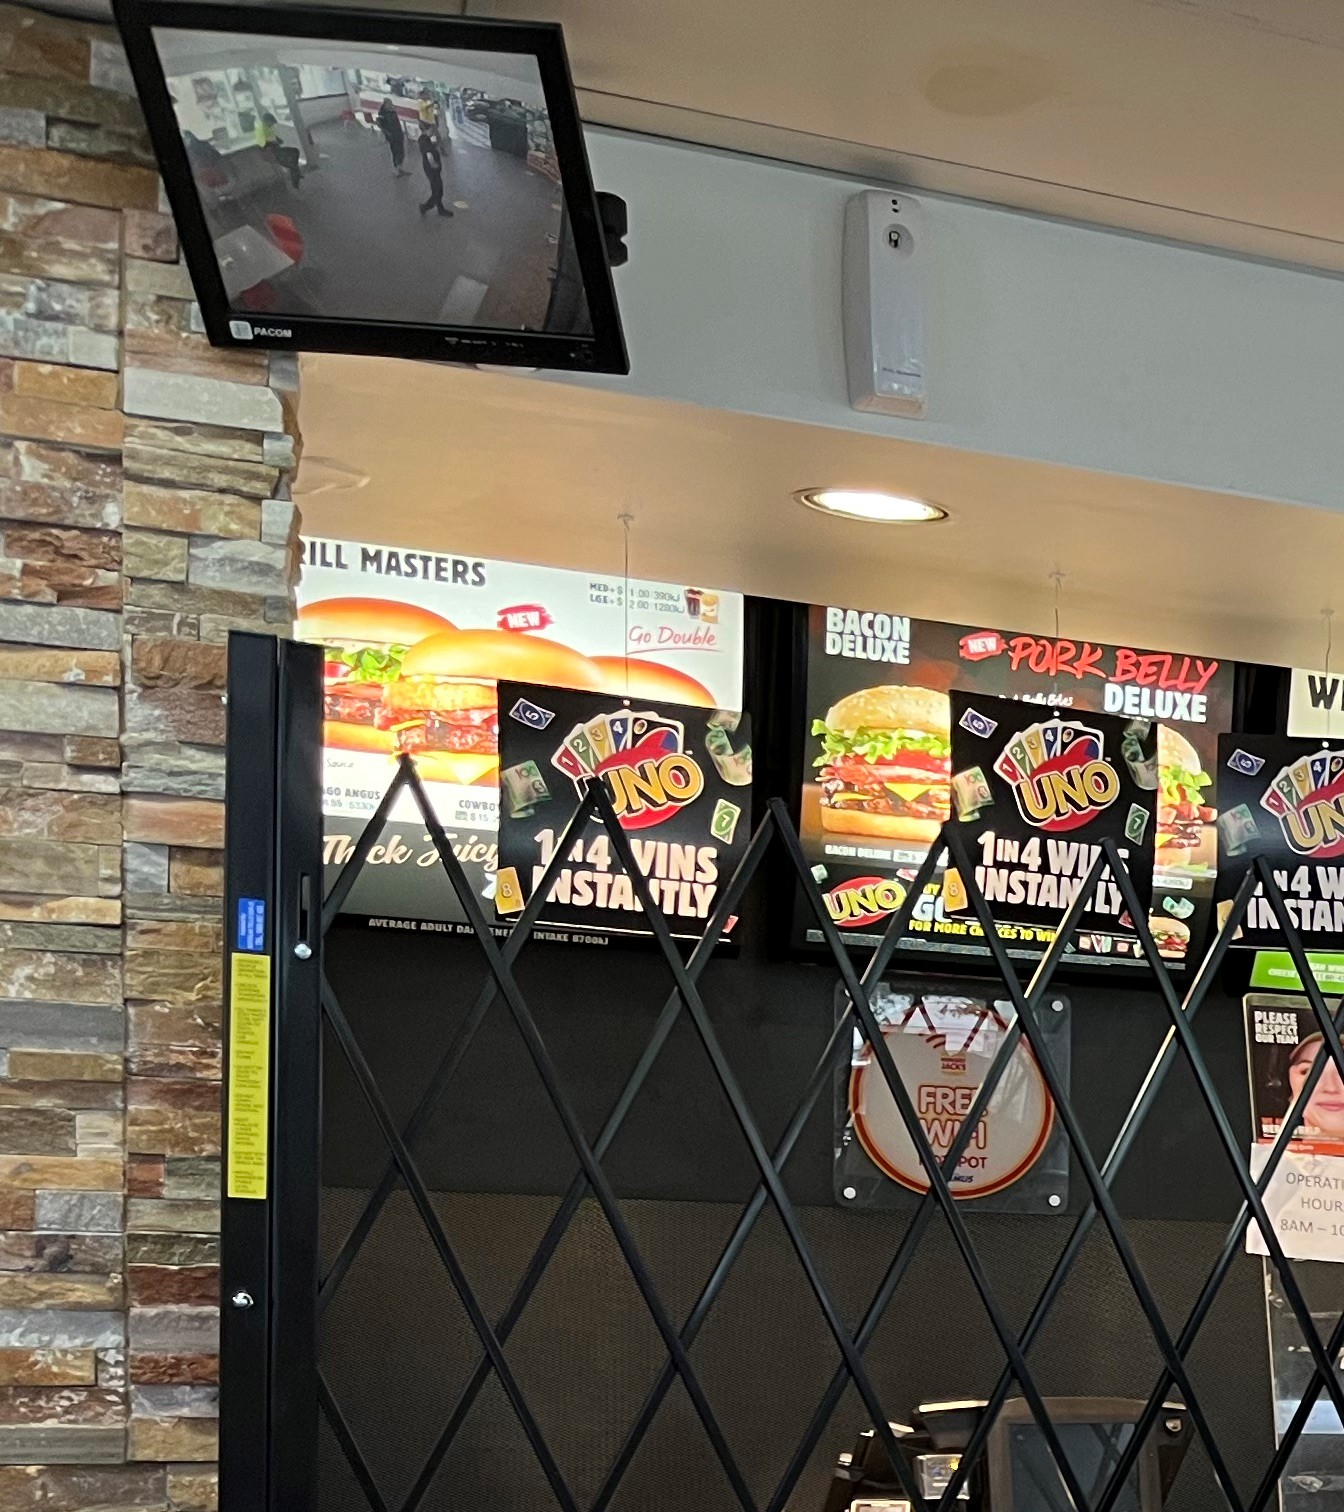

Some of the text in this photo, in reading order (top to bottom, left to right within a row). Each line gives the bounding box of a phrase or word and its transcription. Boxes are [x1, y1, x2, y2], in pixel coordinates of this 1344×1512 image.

[253, 327, 292, 338] PACOM
[360, 547, 486, 588] MASTERS
[506, 612, 540, 630] NEW
[826, 607, 911, 642] BACON
[629, 626, 717, 645] Go Double
[825, 631, 910, 665] DELUXE
[967, 636, 997, 654] NEW
[1008, 636, 1219, 693] PORK BELLY
[1103, 683, 1208, 724] DELUXE
[345, 787, 381, 801] ANGUS
[1019, 763, 1118, 820] UNO
[586, 835, 612, 872] 4
[977, 831, 996, 867] 1
[996, 838, 1020, 863] IN
[1021, 837, 1042, 872] 4
[1290, 865, 1312, 898] 4
[822, 879, 908, 920] UNO
[368, 918, 417, 931] AVERAGE
[420, 922, 454, 934] ADULT
[533, 931, 569, 943] INTAKE
[908, 920, 932, 932] FOR
[934, 921, 967, 935] MORE
[1254, 1010, 1297, 1025] PLEASE
[1255, 1022, 1298, 1037] RESPECT
[1255, 1033, 1299, 1045] OUR TEAM
[1280, 1218, 1314, 1235] 8AM
